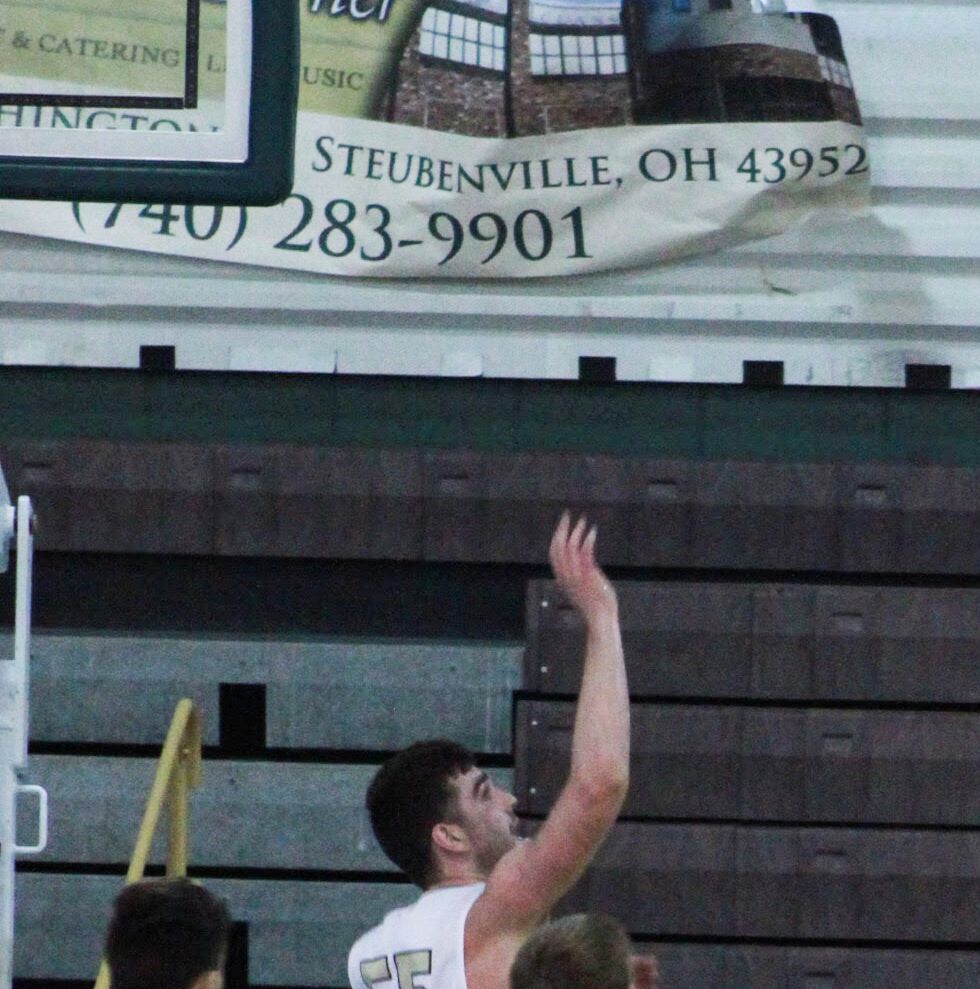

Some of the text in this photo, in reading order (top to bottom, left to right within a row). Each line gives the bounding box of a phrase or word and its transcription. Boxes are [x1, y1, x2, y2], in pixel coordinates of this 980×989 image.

[12, 31, 33, 49] &
[38, 34, 181, 68] CATERING
[303, 66, 364, 91] USIC
[311, 136, 869, 194] STEUBENVILLE, OH 43952
[273, 193, 593, 266] 283-9901
